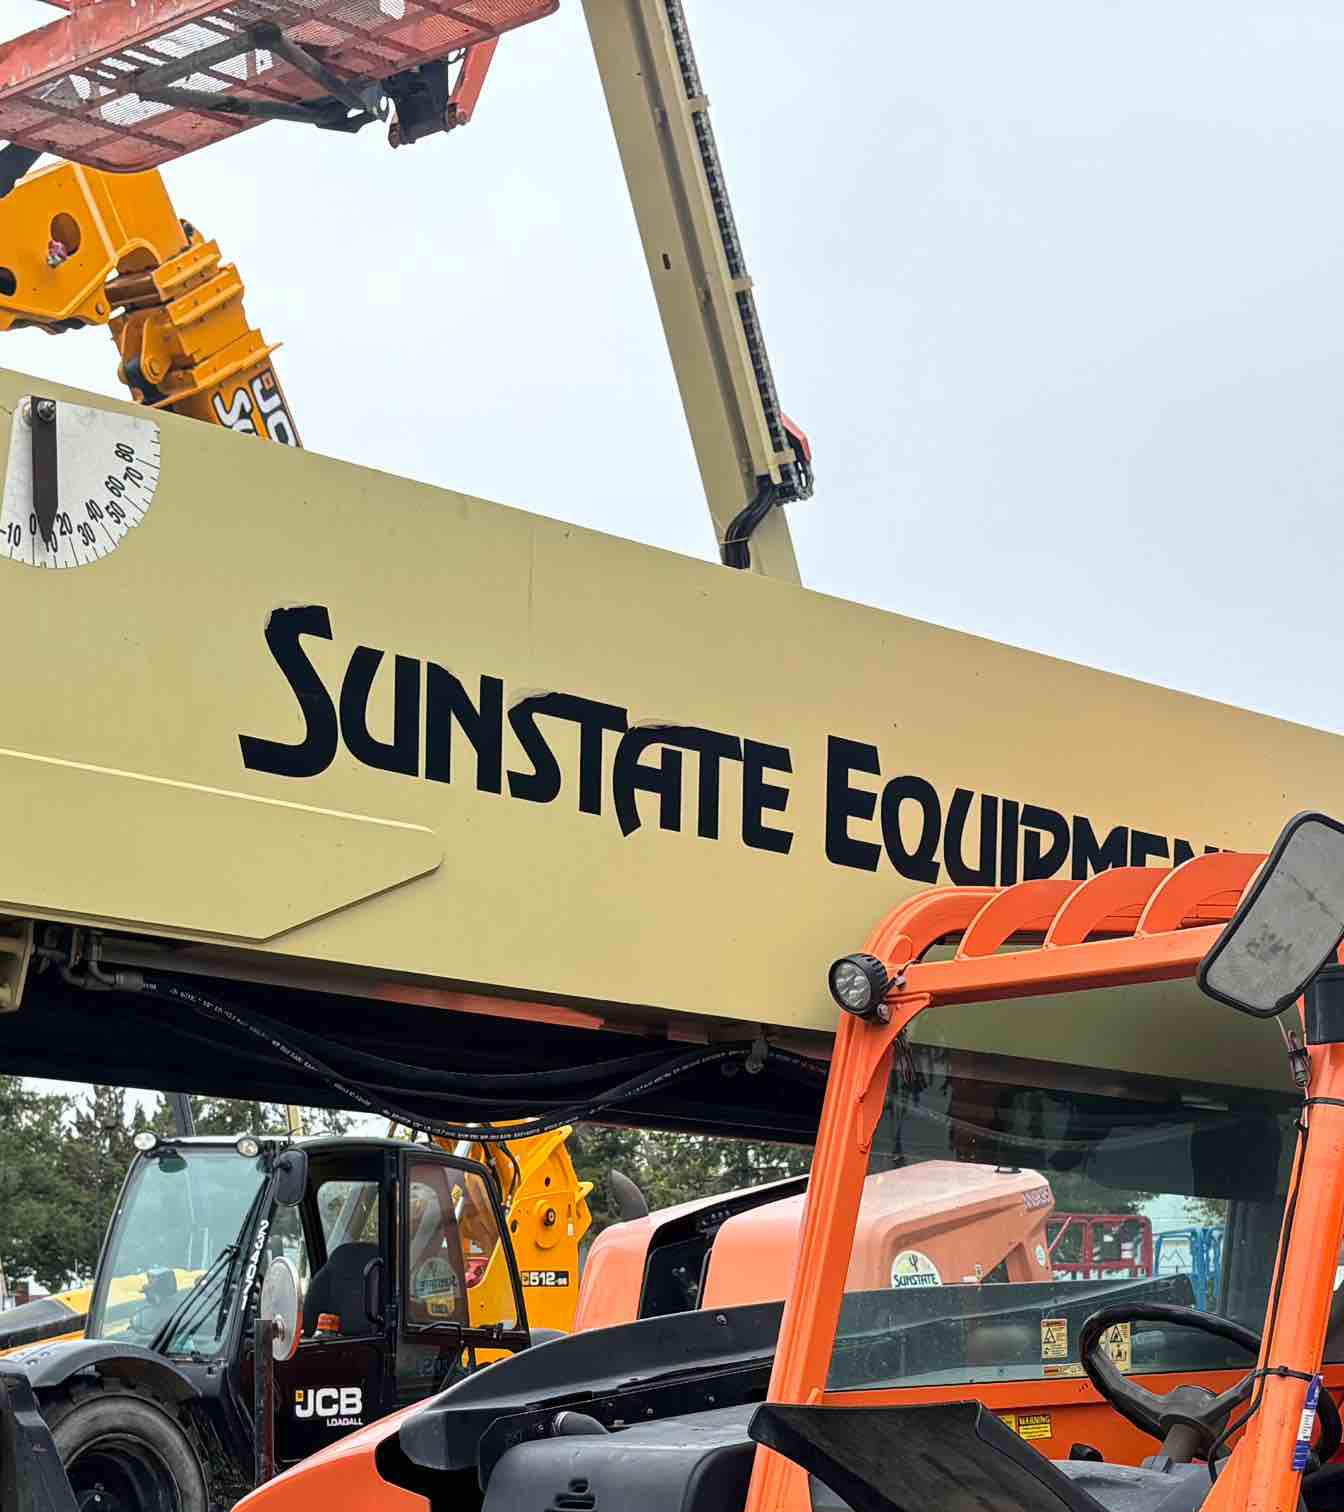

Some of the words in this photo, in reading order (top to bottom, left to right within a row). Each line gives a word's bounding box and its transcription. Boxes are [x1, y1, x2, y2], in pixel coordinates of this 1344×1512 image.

[114, 442, 135, 463] 80
[104, 475, 126, 498] 60
[123, 466, 144, 489] 70
[56, 511, 73, 536] 20
[84, 499, 104, 524] 40
[105, 500, 127, 524] 50
[77, 522, 97, 546] 30
[239, 605, 795, 856] SUNSTATE
[825, 735, 1246, 887] EQUIPM
[240, 1220, 270, 1311] 234071
[894, 1273, 939, 1287] SUNSTATE
[295, 1387, 362, 1417] JCB
[326, 1418, 363, 1427] LOADALL
